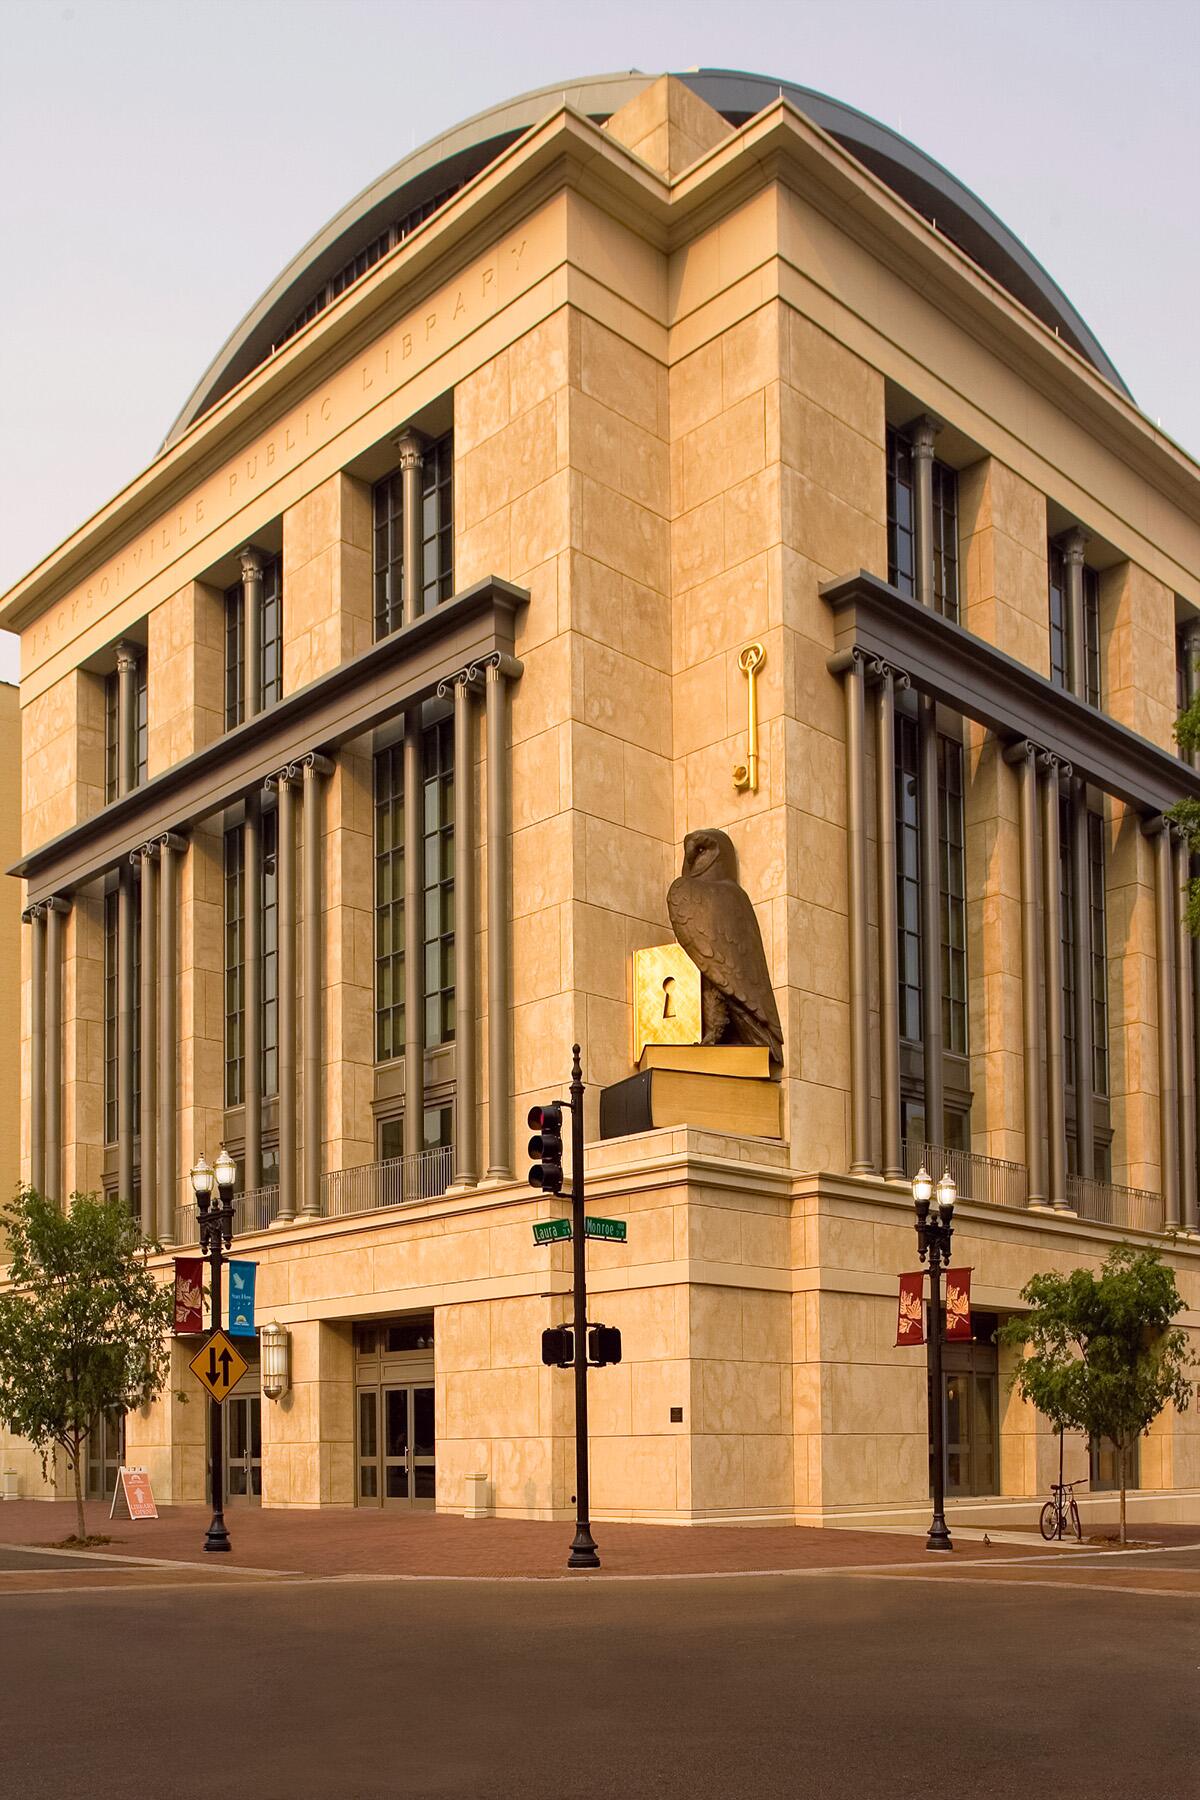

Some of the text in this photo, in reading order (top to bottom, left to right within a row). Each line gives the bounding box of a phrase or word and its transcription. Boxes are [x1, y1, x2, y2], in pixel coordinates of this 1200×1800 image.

[31, 240, 527, 656] JACKSONVILLE PUBLIC LIBRARY
[534, 1226, 558, 1240] Laura
[587, 1219, 614, 1235] Monroe
